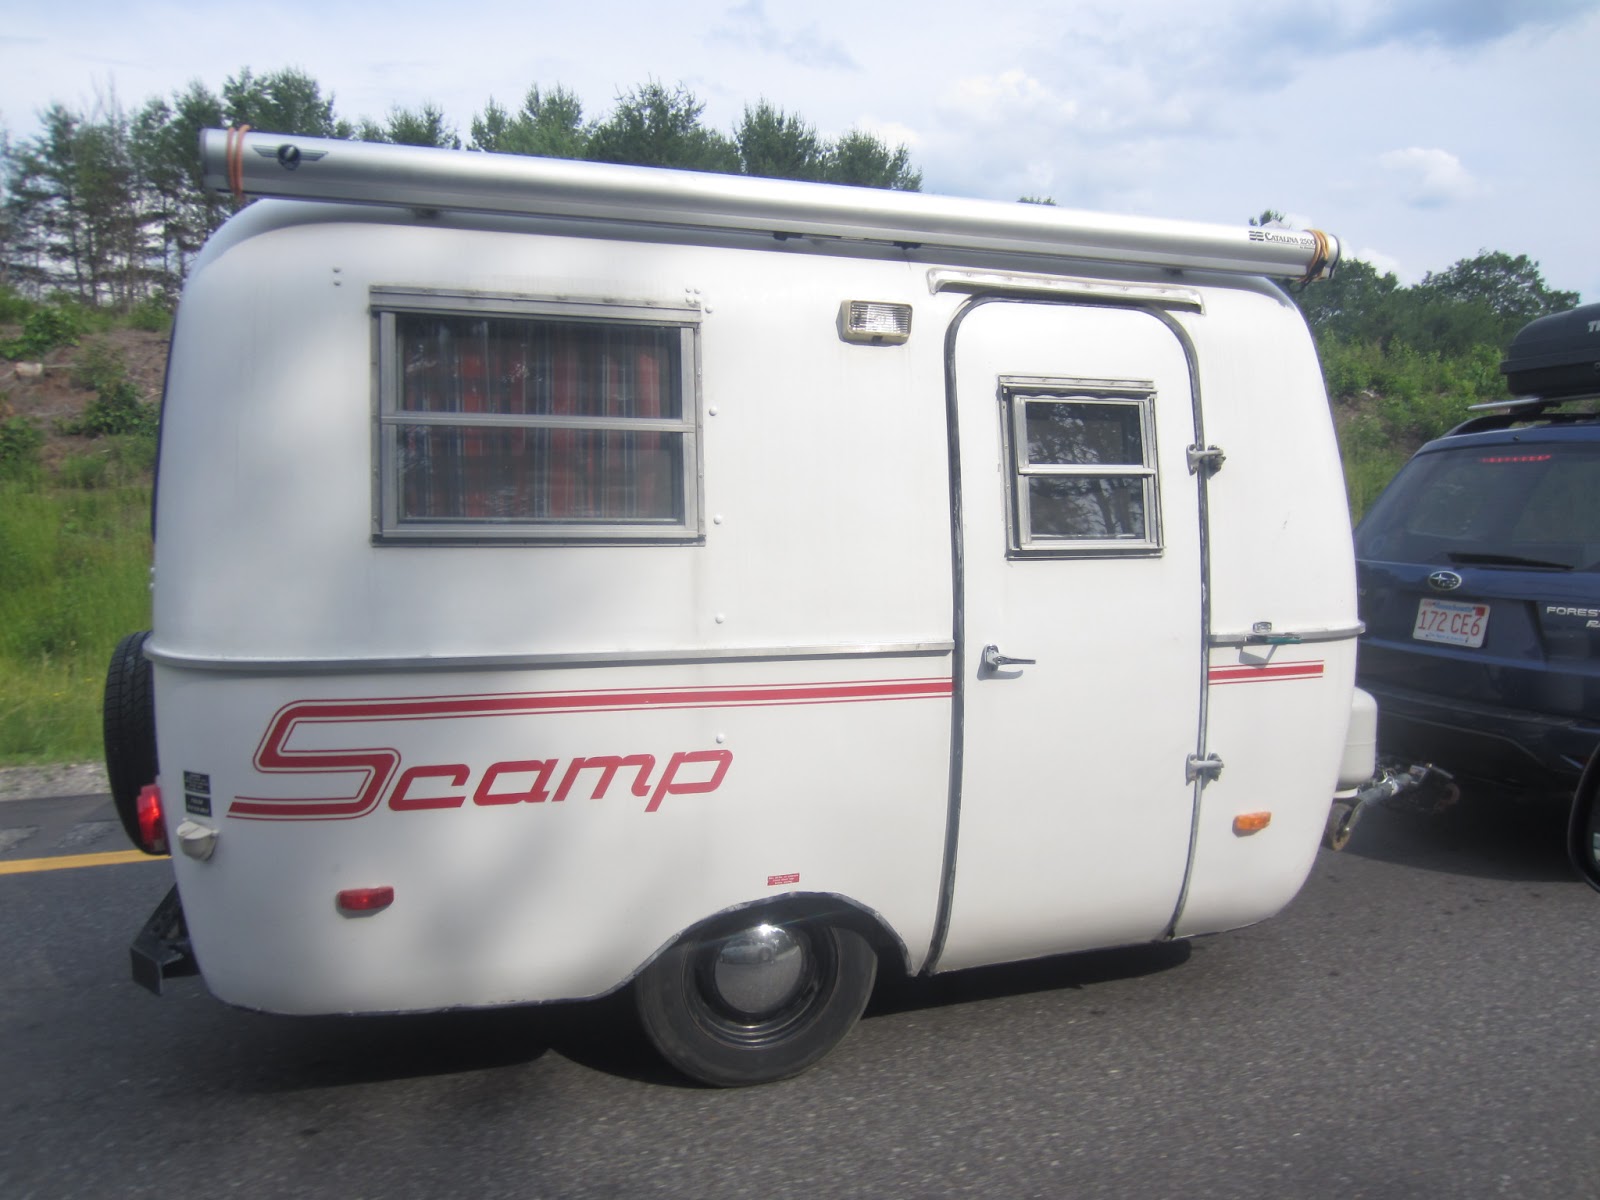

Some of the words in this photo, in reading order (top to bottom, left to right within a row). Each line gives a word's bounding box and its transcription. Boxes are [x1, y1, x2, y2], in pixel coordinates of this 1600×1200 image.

[1418, 610, 1448, 632] 172
[1450, 613, 1482, 637] CE6
[1546, 606, 1600, 617] FORES
[226, 698, 734, 821] Scamp
